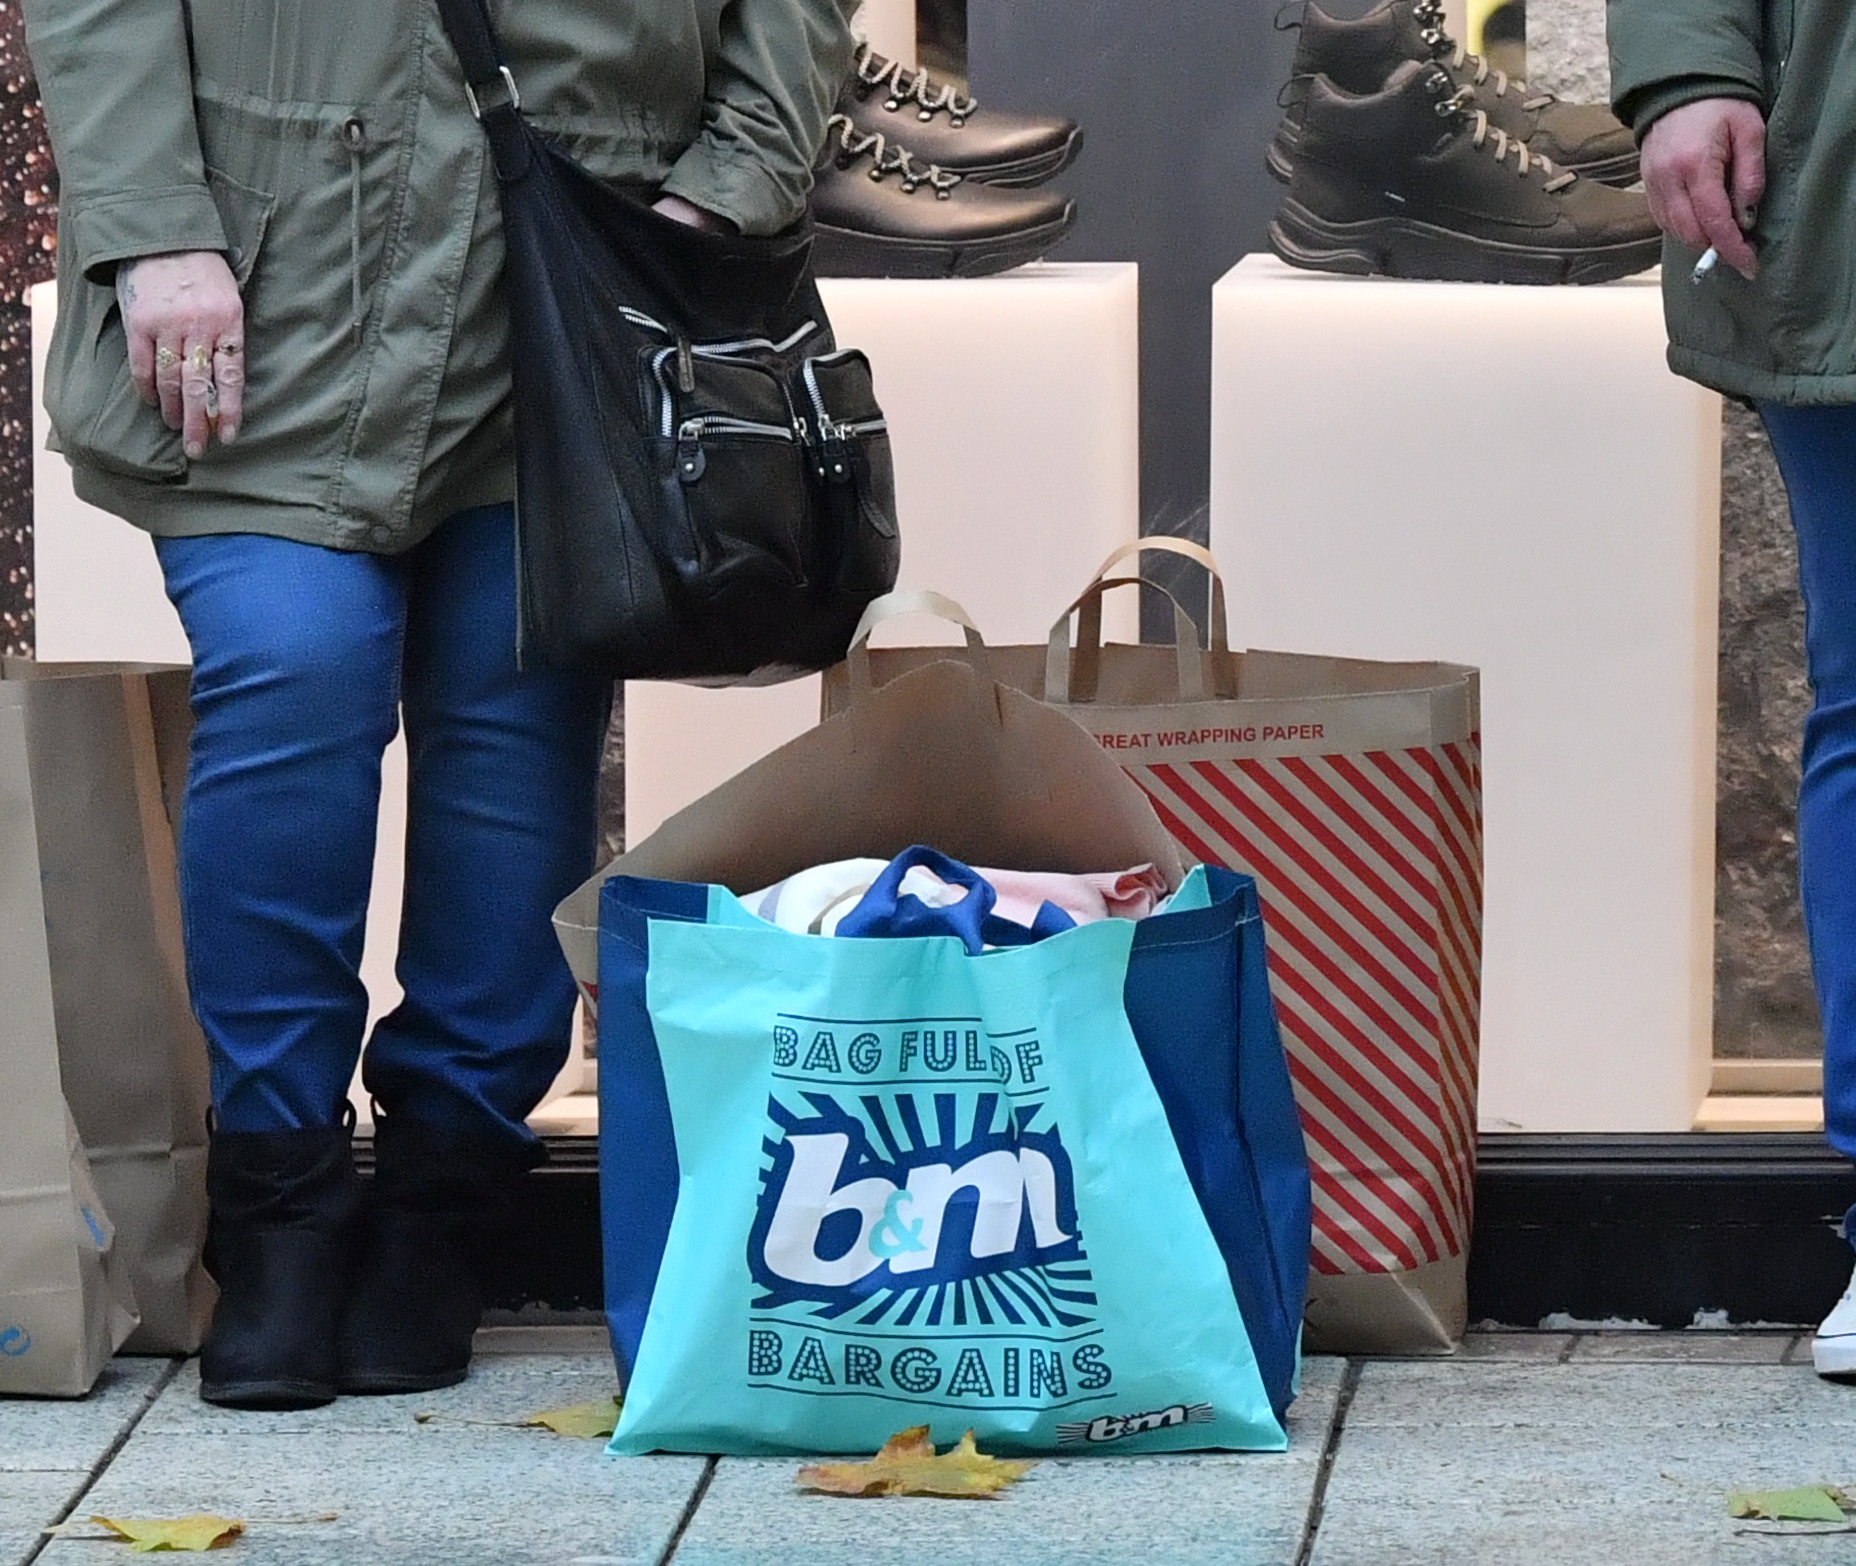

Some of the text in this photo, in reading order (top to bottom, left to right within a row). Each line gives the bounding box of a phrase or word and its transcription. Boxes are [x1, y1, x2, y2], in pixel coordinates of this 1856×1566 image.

[1157, 728, 1256, 746] WRAPPING
[1263, 724, 1324, 741] PAPER
[772, 1025, 882, 1075] BAG
[763, 1132, 1074, 1287] b&m
[747, 1329, 1113, 1398] BARGAINS
